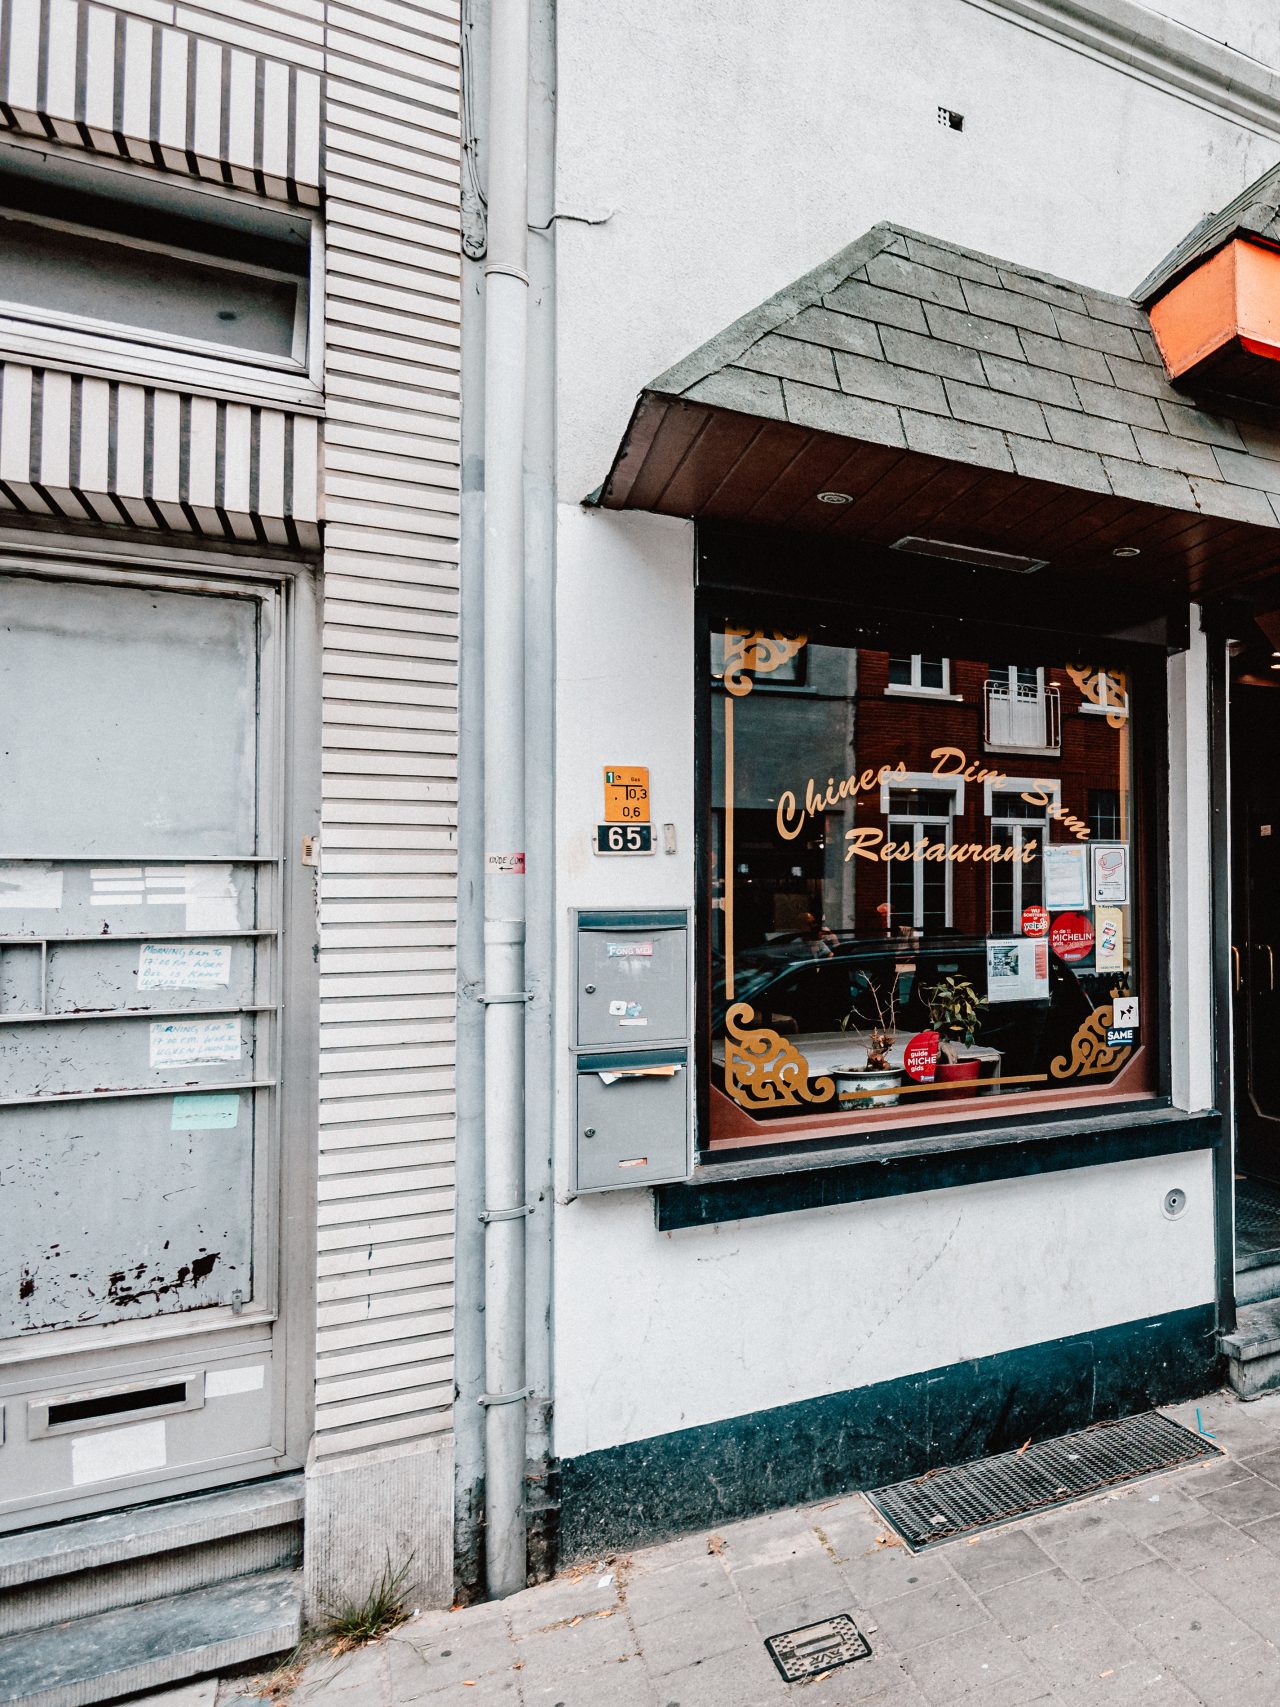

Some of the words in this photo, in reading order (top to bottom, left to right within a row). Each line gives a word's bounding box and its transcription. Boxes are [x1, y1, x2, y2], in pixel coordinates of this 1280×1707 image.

[607, 772, 614, 783] 1
[629, 788, 647, 801] 0,3
[776, 761, 911, 841] Chinees
[930, 747, 1008, 789] Dim
[1020, 778, 1091, 841] Sum
[622, 806, 641, 819] 0,6
[608, 826, 641, 850] 65
[844, 827, 1038, 863] Restaurant
[1024, 921, 1040, 931] yelp
[1052, 933, 1092, 941] MICHELIN
[609, 946, 634, 955] FONG
[1107, 1029, 1133, 1040] SAME
[910, 1050, 928, 1058] guide
